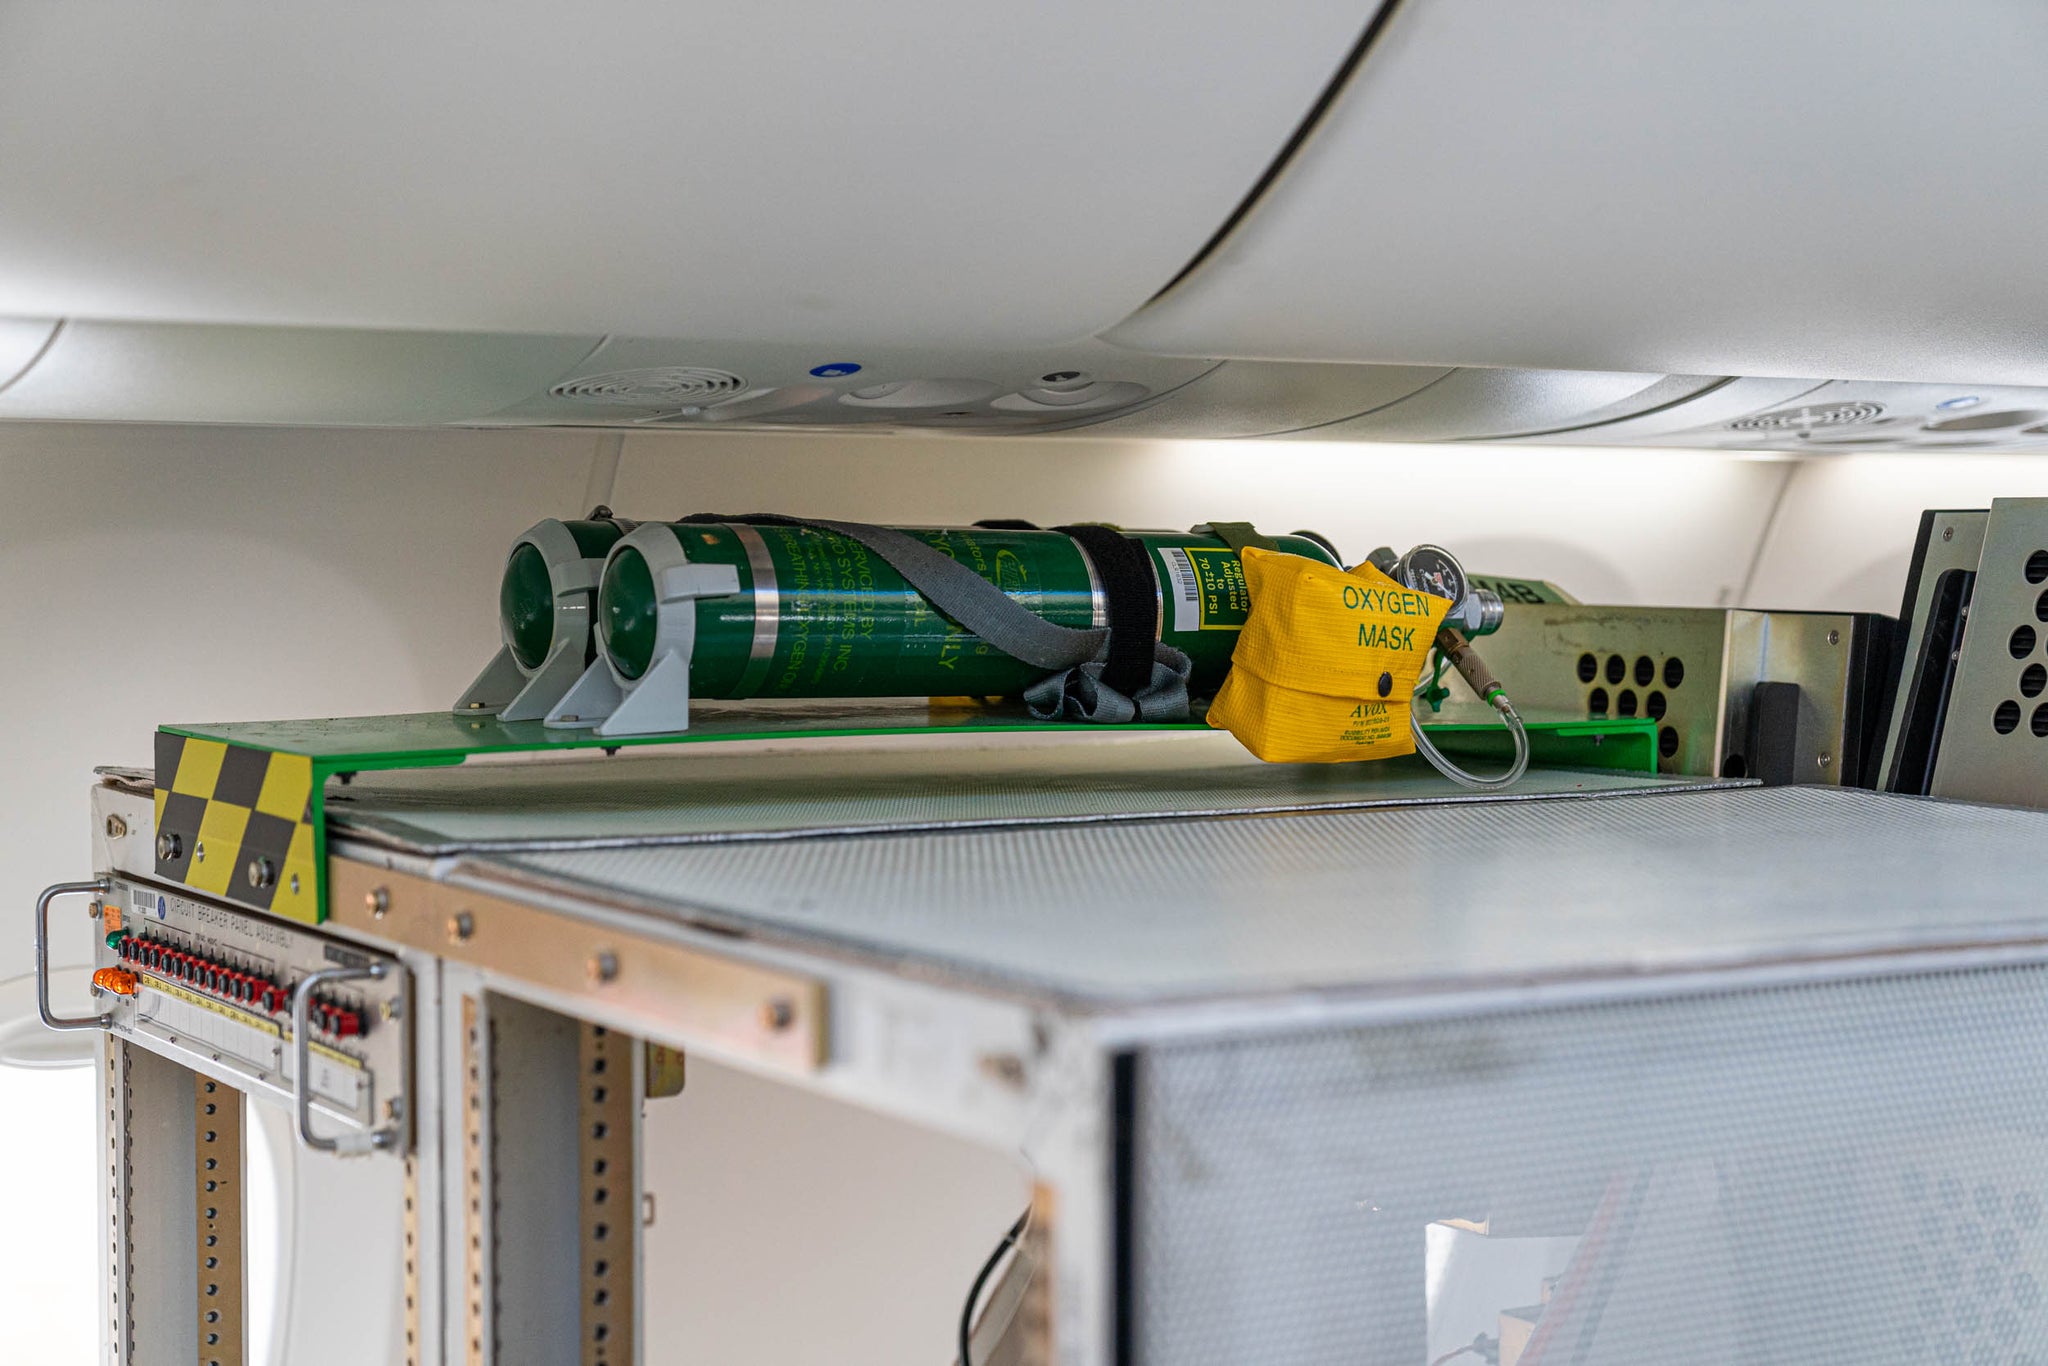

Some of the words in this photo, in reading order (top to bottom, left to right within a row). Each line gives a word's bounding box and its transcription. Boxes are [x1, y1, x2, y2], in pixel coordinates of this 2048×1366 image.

[837, 558, 857, 640] SYSTEMS
[1216, 578, 1225, 590] to
[1220, 561, 1240, 610] Adjusted
[1231, 560, 1249, 613] Regulator
[1208, 594, 1218, 615] PSI
[1343, 585, 1429, 617] OXYGEN
[860, 617, 874, 640] BY
[1358, 623, 1416, 651] MASK
[938, 622, 962, 670] NLY
[1350, 701, 1387, 718] AVOX
[170, 897, 195, 920] CIRCUIT
[198, 904, 228, 930] BREAKER
[231, 914, 254, 938] PANEL
